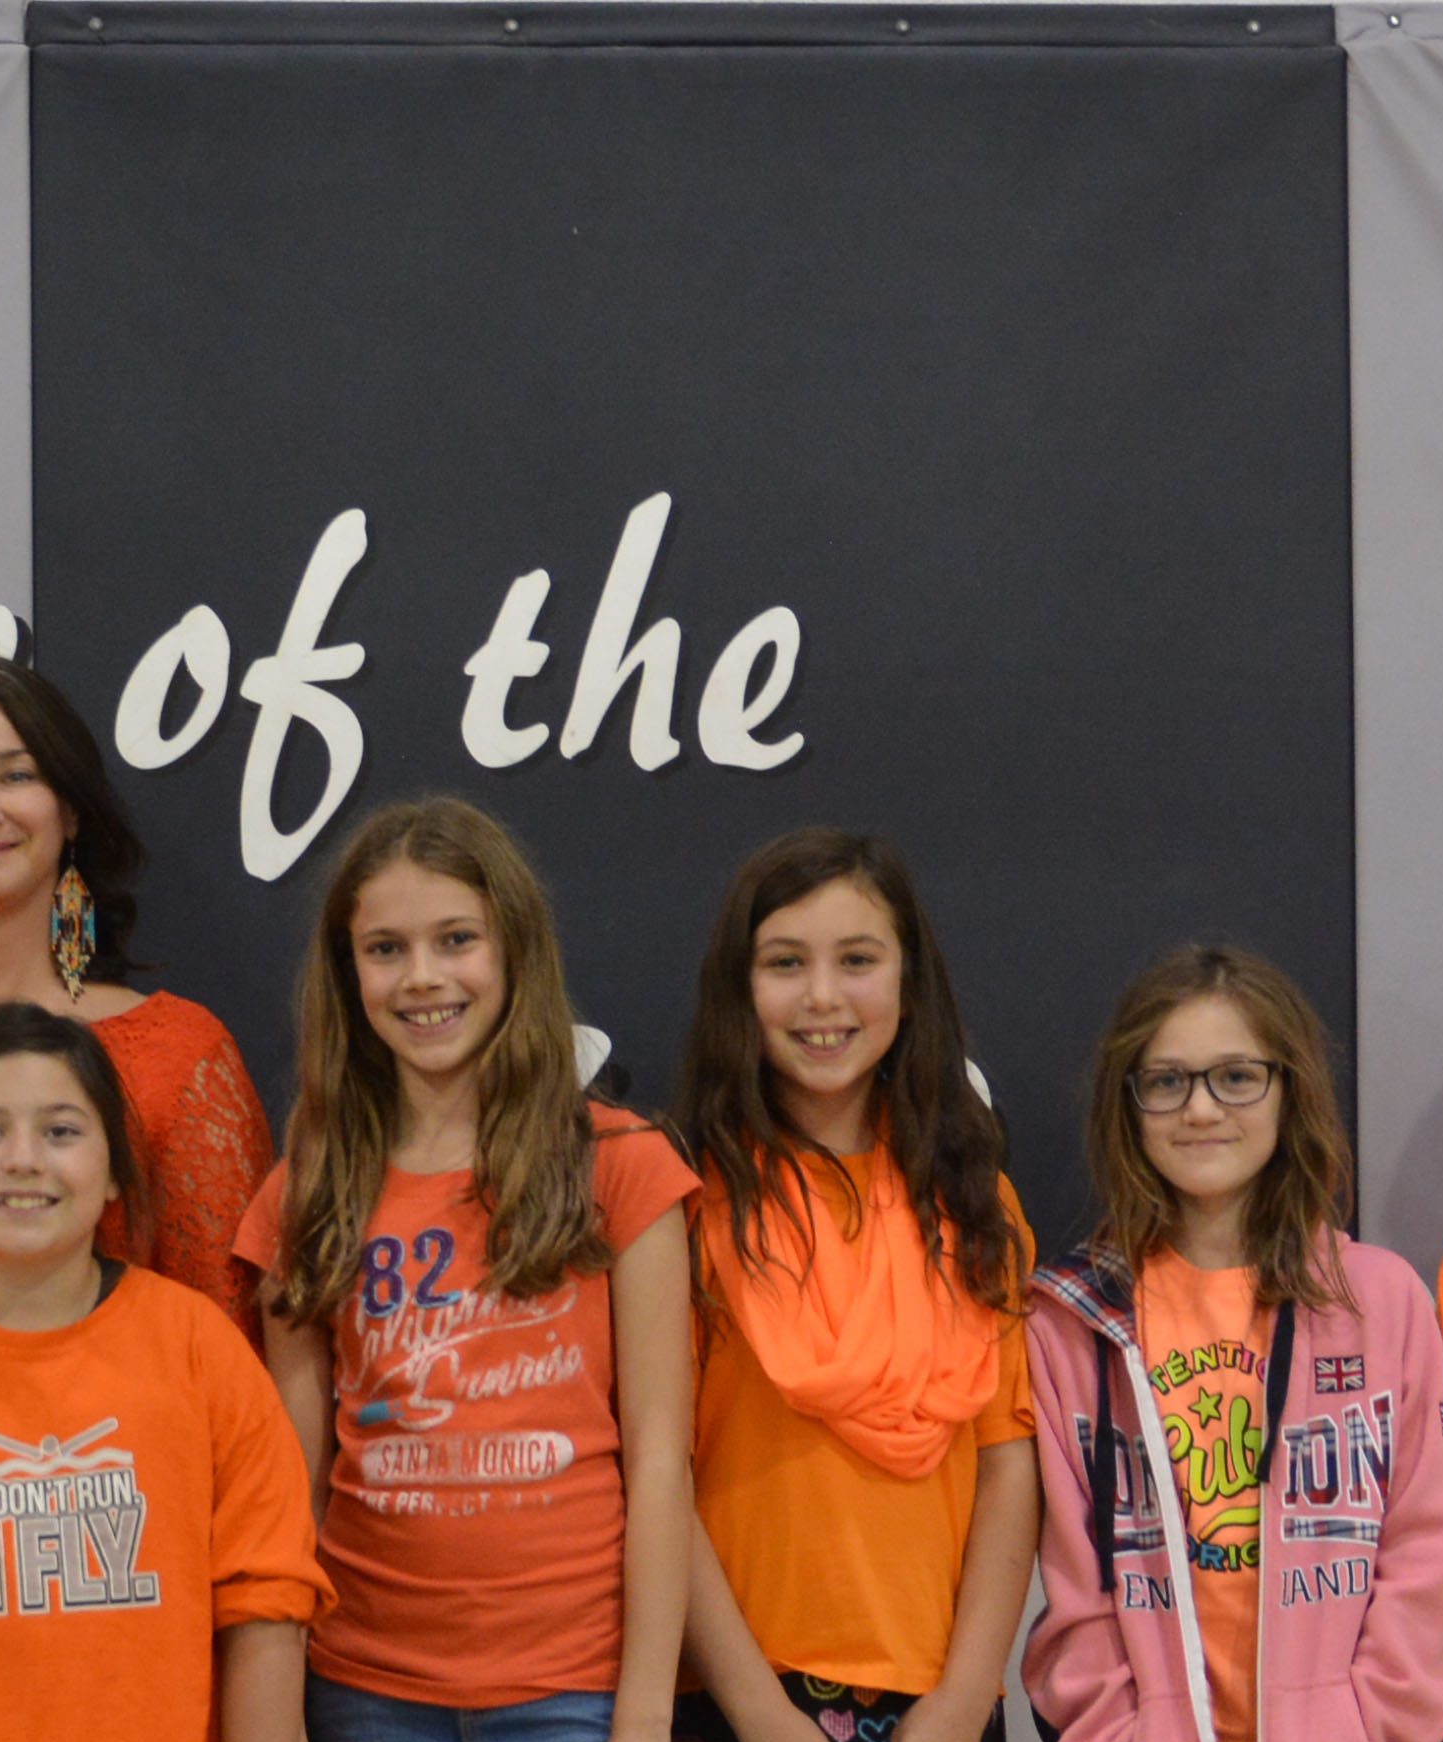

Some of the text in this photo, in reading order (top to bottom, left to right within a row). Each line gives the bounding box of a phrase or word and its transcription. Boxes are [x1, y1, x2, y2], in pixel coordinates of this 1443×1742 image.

[115, 508, 368, 882] of
[462, 491, 804, 771] the
[362, 1226, 462, 1319] 82
[76, 1470, 142, 1512] RUN.
[377, 1439, 560, 1477] SANTA MONICA
[18, 1507, 157, 1611] FLY.
